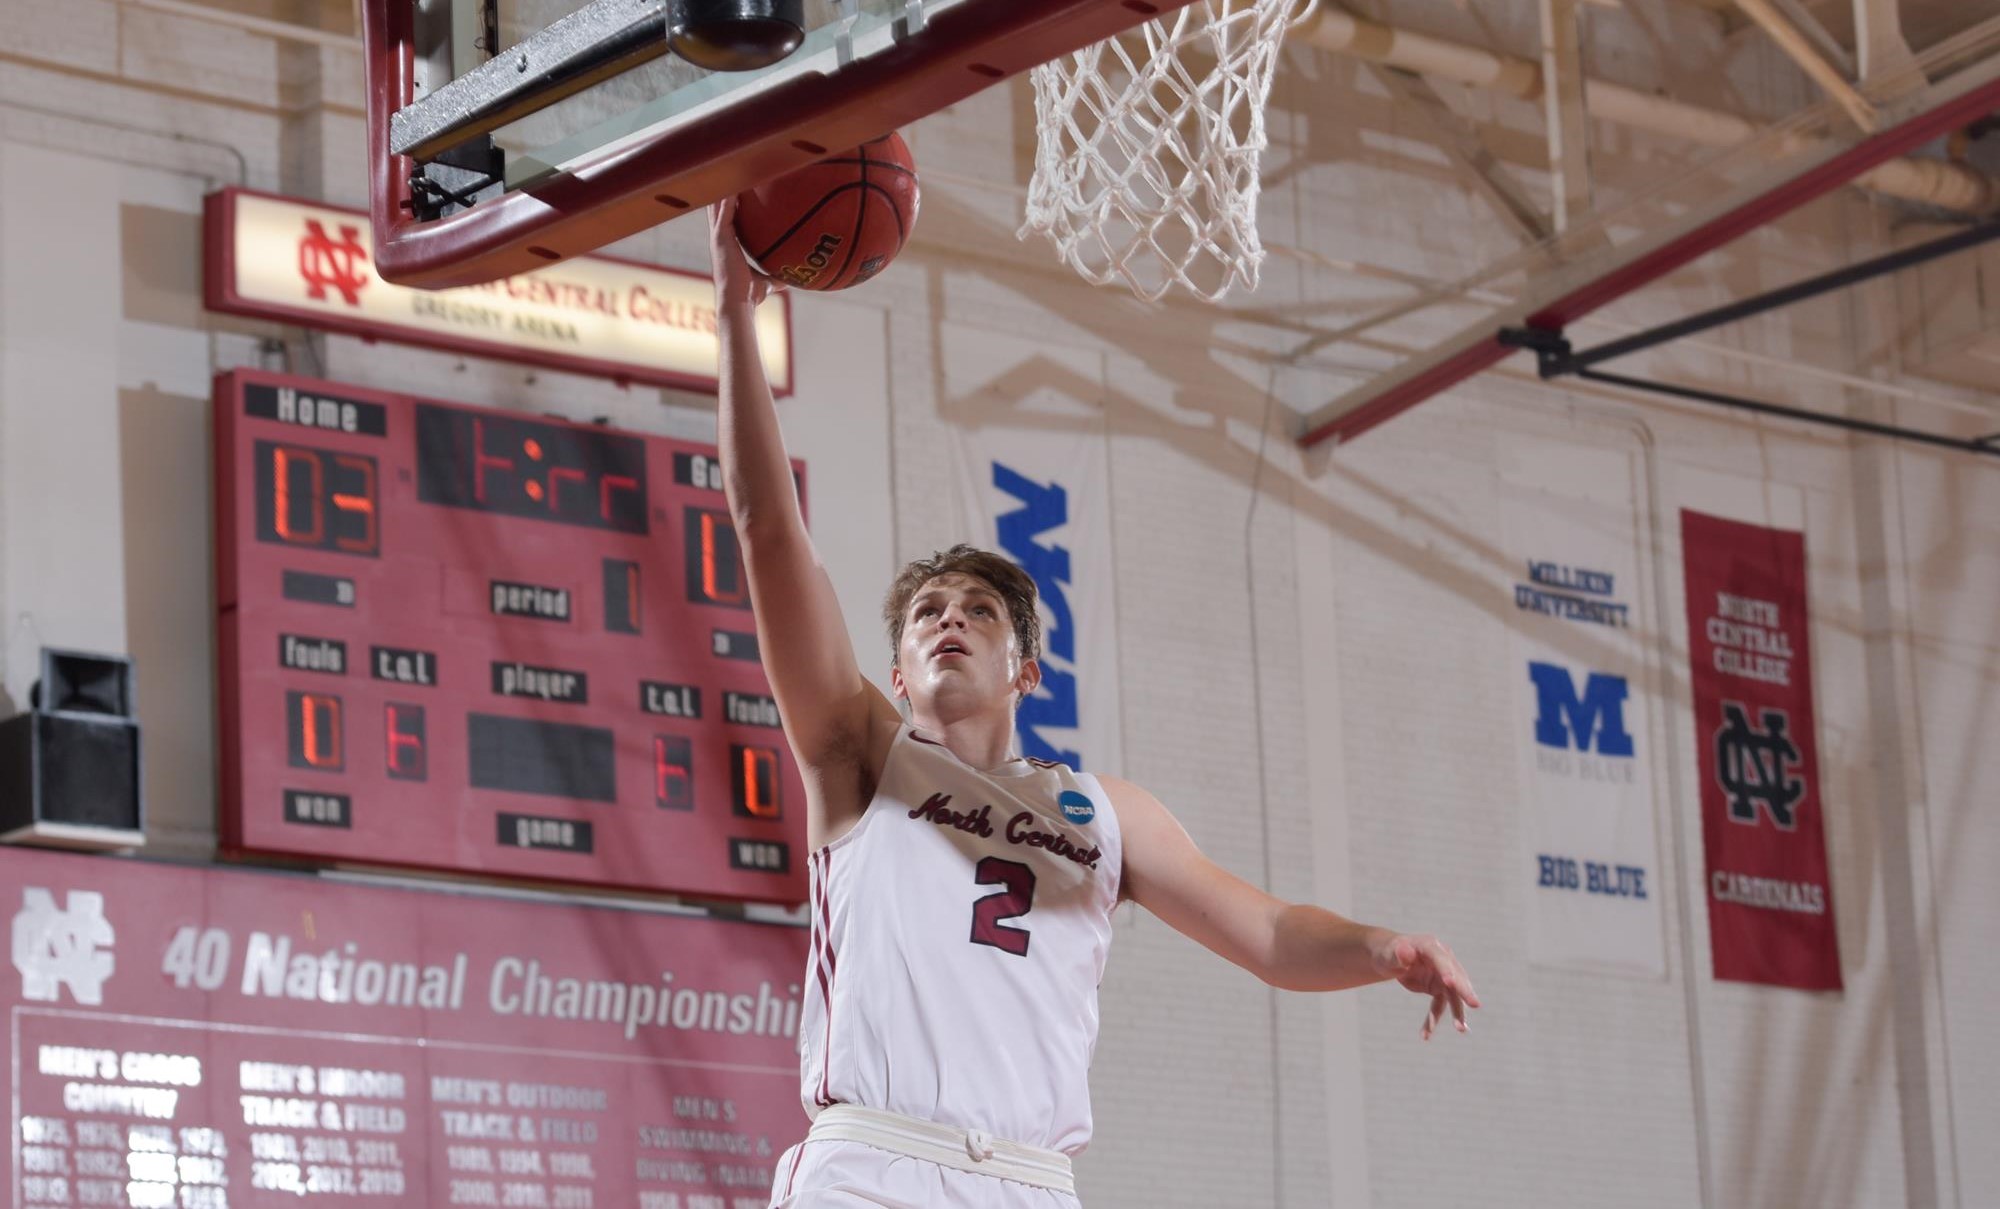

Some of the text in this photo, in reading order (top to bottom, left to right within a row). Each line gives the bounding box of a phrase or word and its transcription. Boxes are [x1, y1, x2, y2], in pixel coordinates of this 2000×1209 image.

[513, 312, 579, 343] ARENA
[628, 284, 717, 336] COLLEG
[277, 387, 358, 432] Home
[493, 582, 568, 620] period
[1515, 584, 1629, 628] UNIVERSITY
[1717, 592, 1780, 627] NORTH
[1706, 617, 1793, 658] CENTRAL
[502, 663, 577, 698] player
[1714, 649, 1790, 687] COLLEGE
[1528, 661, 1635, 757] M
[296, 795, 341, 822] won
[908, 792, 994, 838] North
[1064, 804, 1093, 816] NCAA
[516, 817, 575, 848] game
[738, 841, 781, 869] won
[1537, 855, 1648, 900] BIG BLUE
[1712, 871, 1824, 915] CARDINALS
[969, 855, 1036, 957] 2
[162, 925, 231, 991] 40
[241, 931, 468, 1009] National
[240, 1061, 316, 1094] MEN'S
[431, 1076, 607, 1111] MEN'S OUTDOOR
[240, 1096, 317, 1129] TRACK
[344, 1103, 406, 1133] FIELD
[441, 1110, 598, 1144] TRACK & FIELD
[673, 1095, 736, 1123] MENS
[639, 1126, 751, 1156] SWIMMING
[637, 1158, 705, 1184] DIVING
